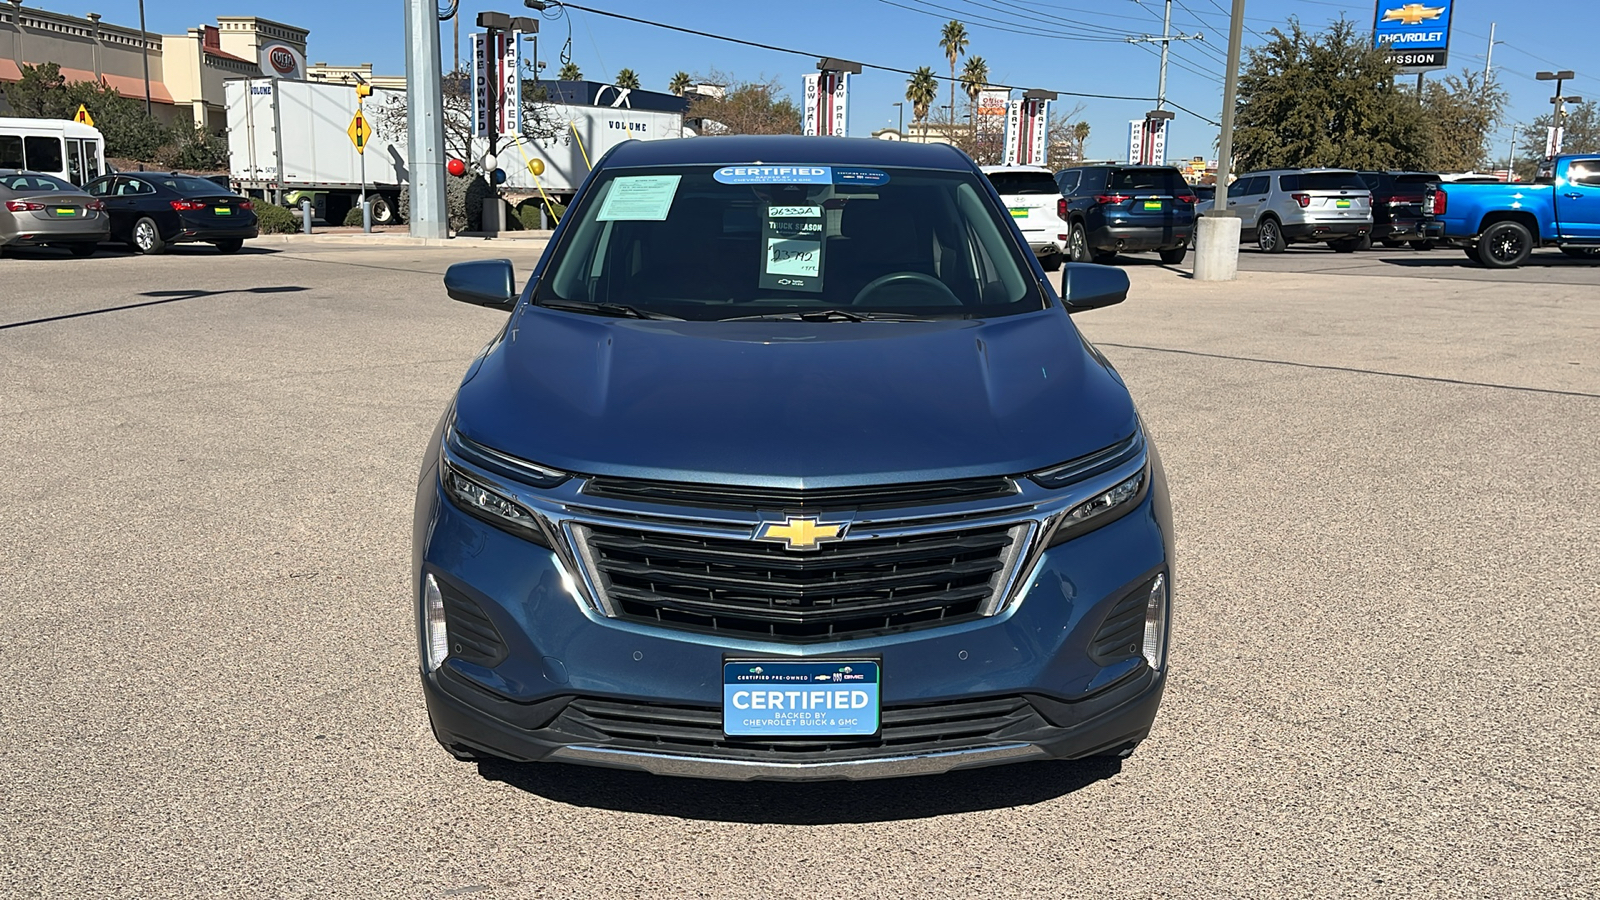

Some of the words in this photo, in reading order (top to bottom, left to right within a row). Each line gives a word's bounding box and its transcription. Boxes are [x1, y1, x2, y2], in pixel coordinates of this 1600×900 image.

[1378, 32, 1443, 43] CHEVROLET
[476, 39, 485, 70] PRE
[506, 38, 515, 68] PRE
[807, 78, 815, 99] LOW
[836, 76, 844, 98] LOW
[477, 76, 486, 131] OWNED
[507, 75, 516, 130] OWNED
[609, 121, 647, 132] VOLUME
[835, 105, 843, 136] PRIC
[1008, 103, 1018, 162] CERTIFIED
[1035, 102, 1045, 162] CERTIFIED
[720, 168, 825, 177] CERTIFIED
[769, 221, 793, 230] TRUCK
[732, 690, 869, 710] CERTIFIED
[838, 718, 858, 726] GMC
